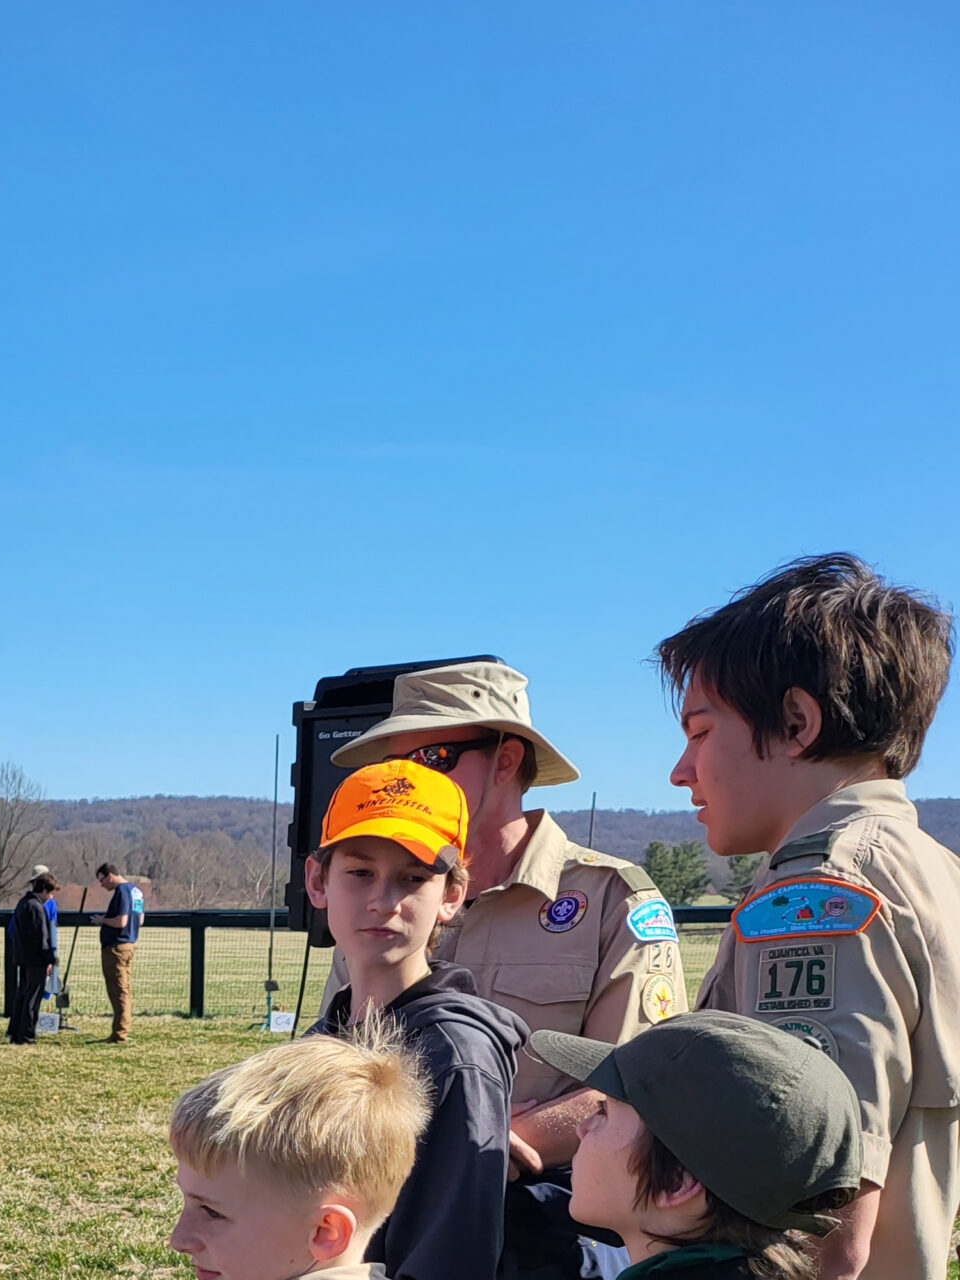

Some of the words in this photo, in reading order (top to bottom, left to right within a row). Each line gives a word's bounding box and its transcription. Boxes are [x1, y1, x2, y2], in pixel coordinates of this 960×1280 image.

[318, 731, 331, 740] Go
[778, 884, 808, 895] CAPITAL
[764, 959, 826, 999] 176
[275, 1016, 291, 1027] C-4
